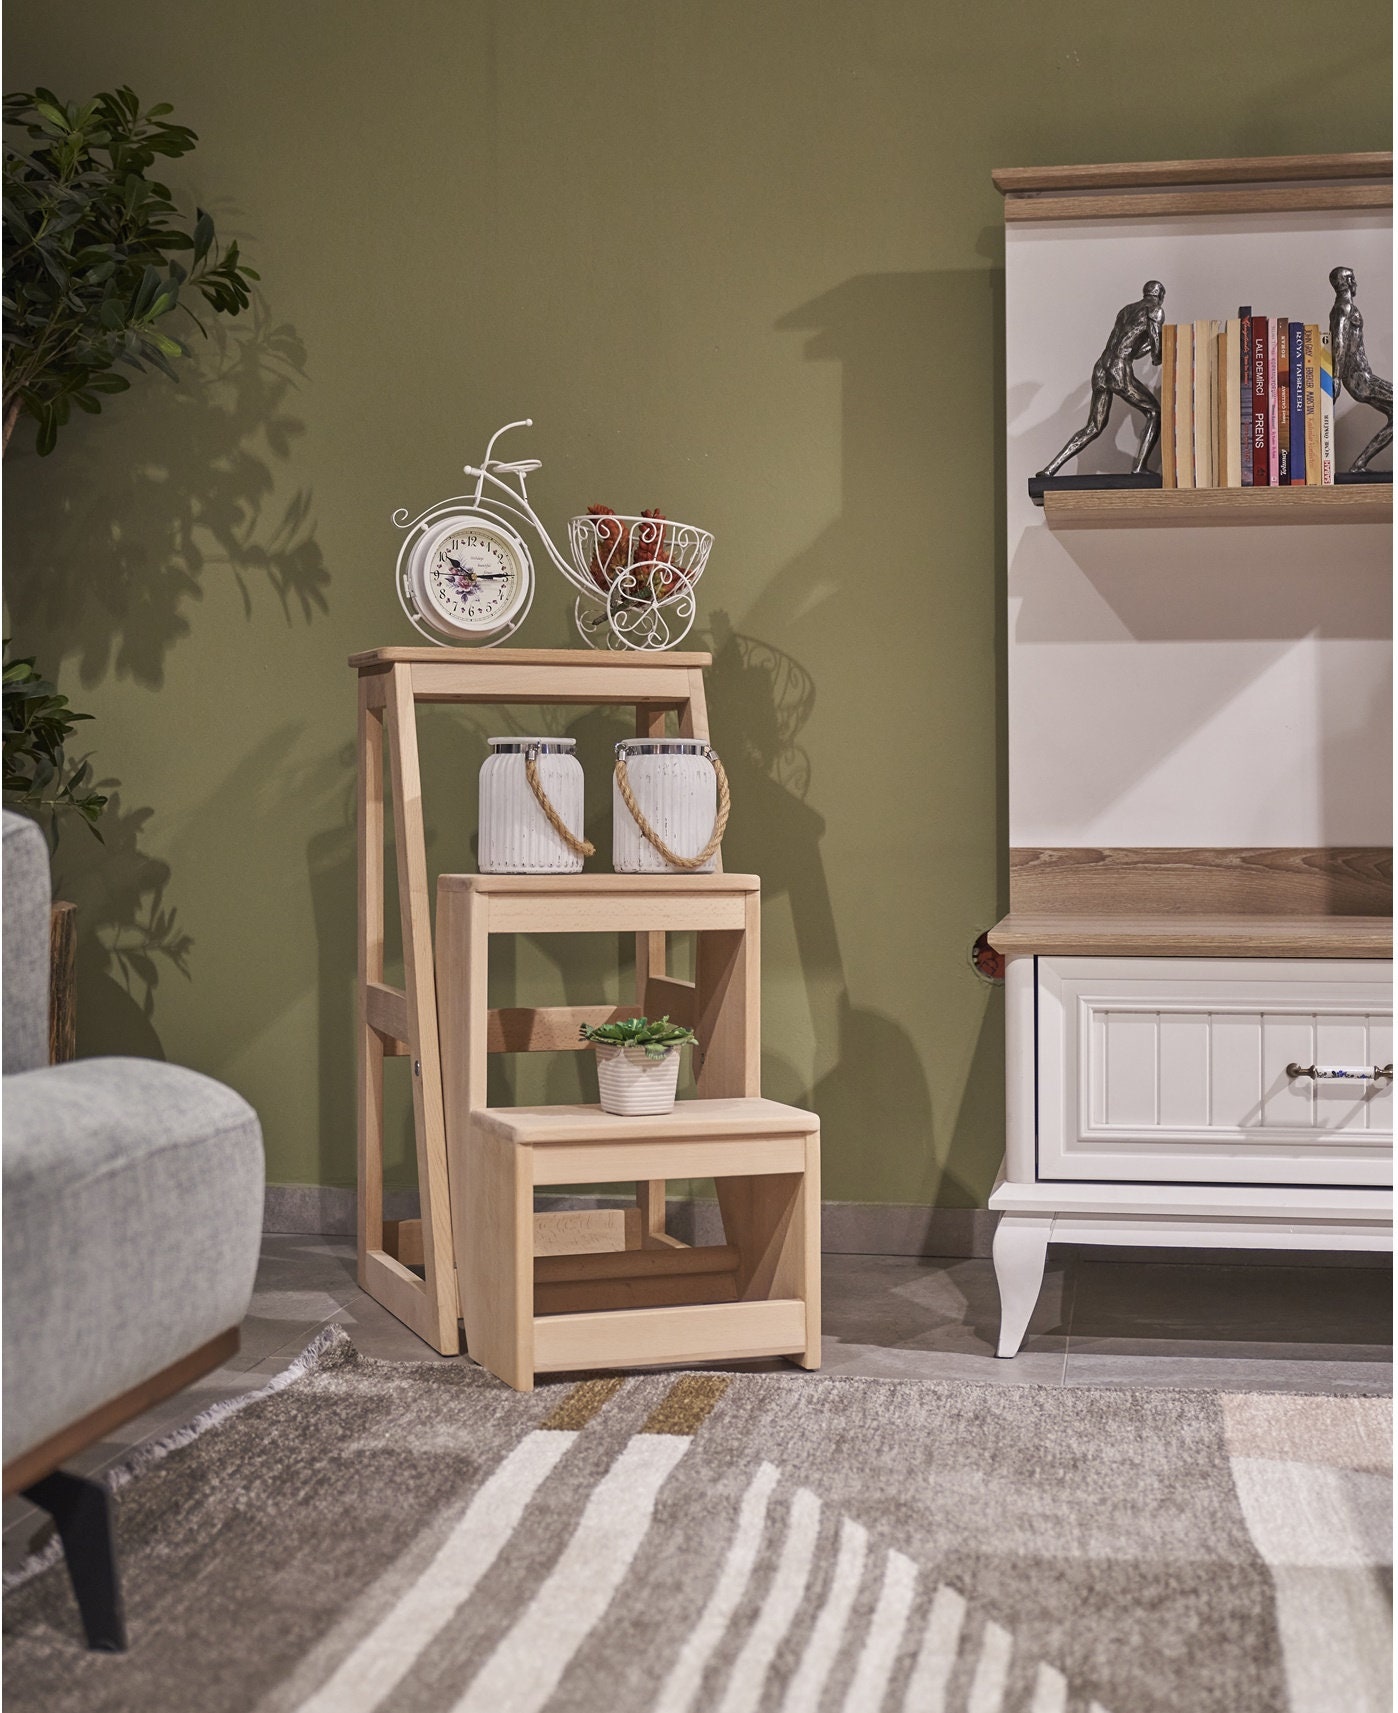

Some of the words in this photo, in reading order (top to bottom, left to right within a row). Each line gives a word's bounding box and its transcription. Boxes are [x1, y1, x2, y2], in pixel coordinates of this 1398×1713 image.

[1304, 329, 1313, 344] JOHN
[1255, 338, 1263, 359] LALE
[1296, 331, 1304, 358] RÜYA
[1305, 344, 1314, 357] GRAY
[1255, 360, 1264, 396] DEMİRCİ
[1306, 367, 1314, 389] ERKEKLER
[1255, 413, 1264, 449] PRENS
[1323, 460, 1331, 485] SABAH
[452, 539, 459, 550] 11
[467, 536, 478, 547] 12
[487, 542, 491, 552] 1
[439, 551, 447, 562] 10
[497, 553, 504, 564] 2
[433, 570, 440, 581] 9
[439, 588, 446, 599] 8
[498, 589, 504, 600] 4
[452, 601, 458, 611] 7
[468, 606, 475, 617] 6
[485, 601, 492, 612] 5
